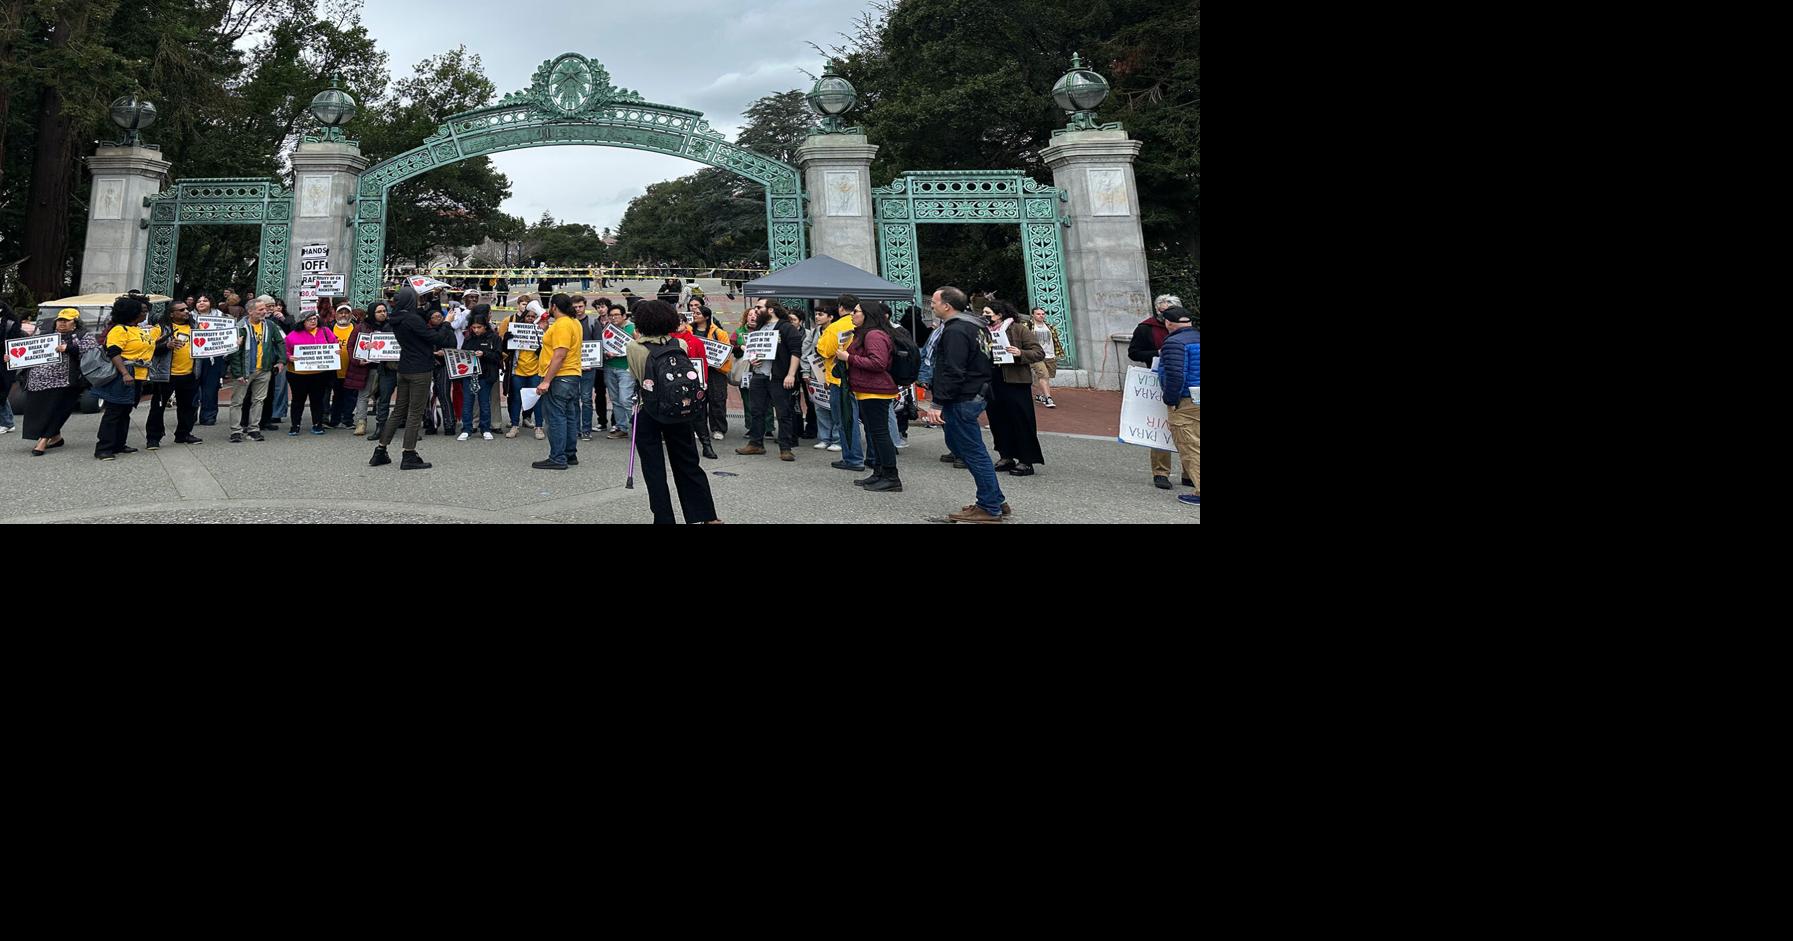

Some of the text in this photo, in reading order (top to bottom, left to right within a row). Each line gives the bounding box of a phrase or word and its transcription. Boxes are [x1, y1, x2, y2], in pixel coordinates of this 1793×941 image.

[305, 260, 325, 270] OFF
[1134, 386, 1164, 401] PARA
[1129, 426, 1157, 442] PARA
